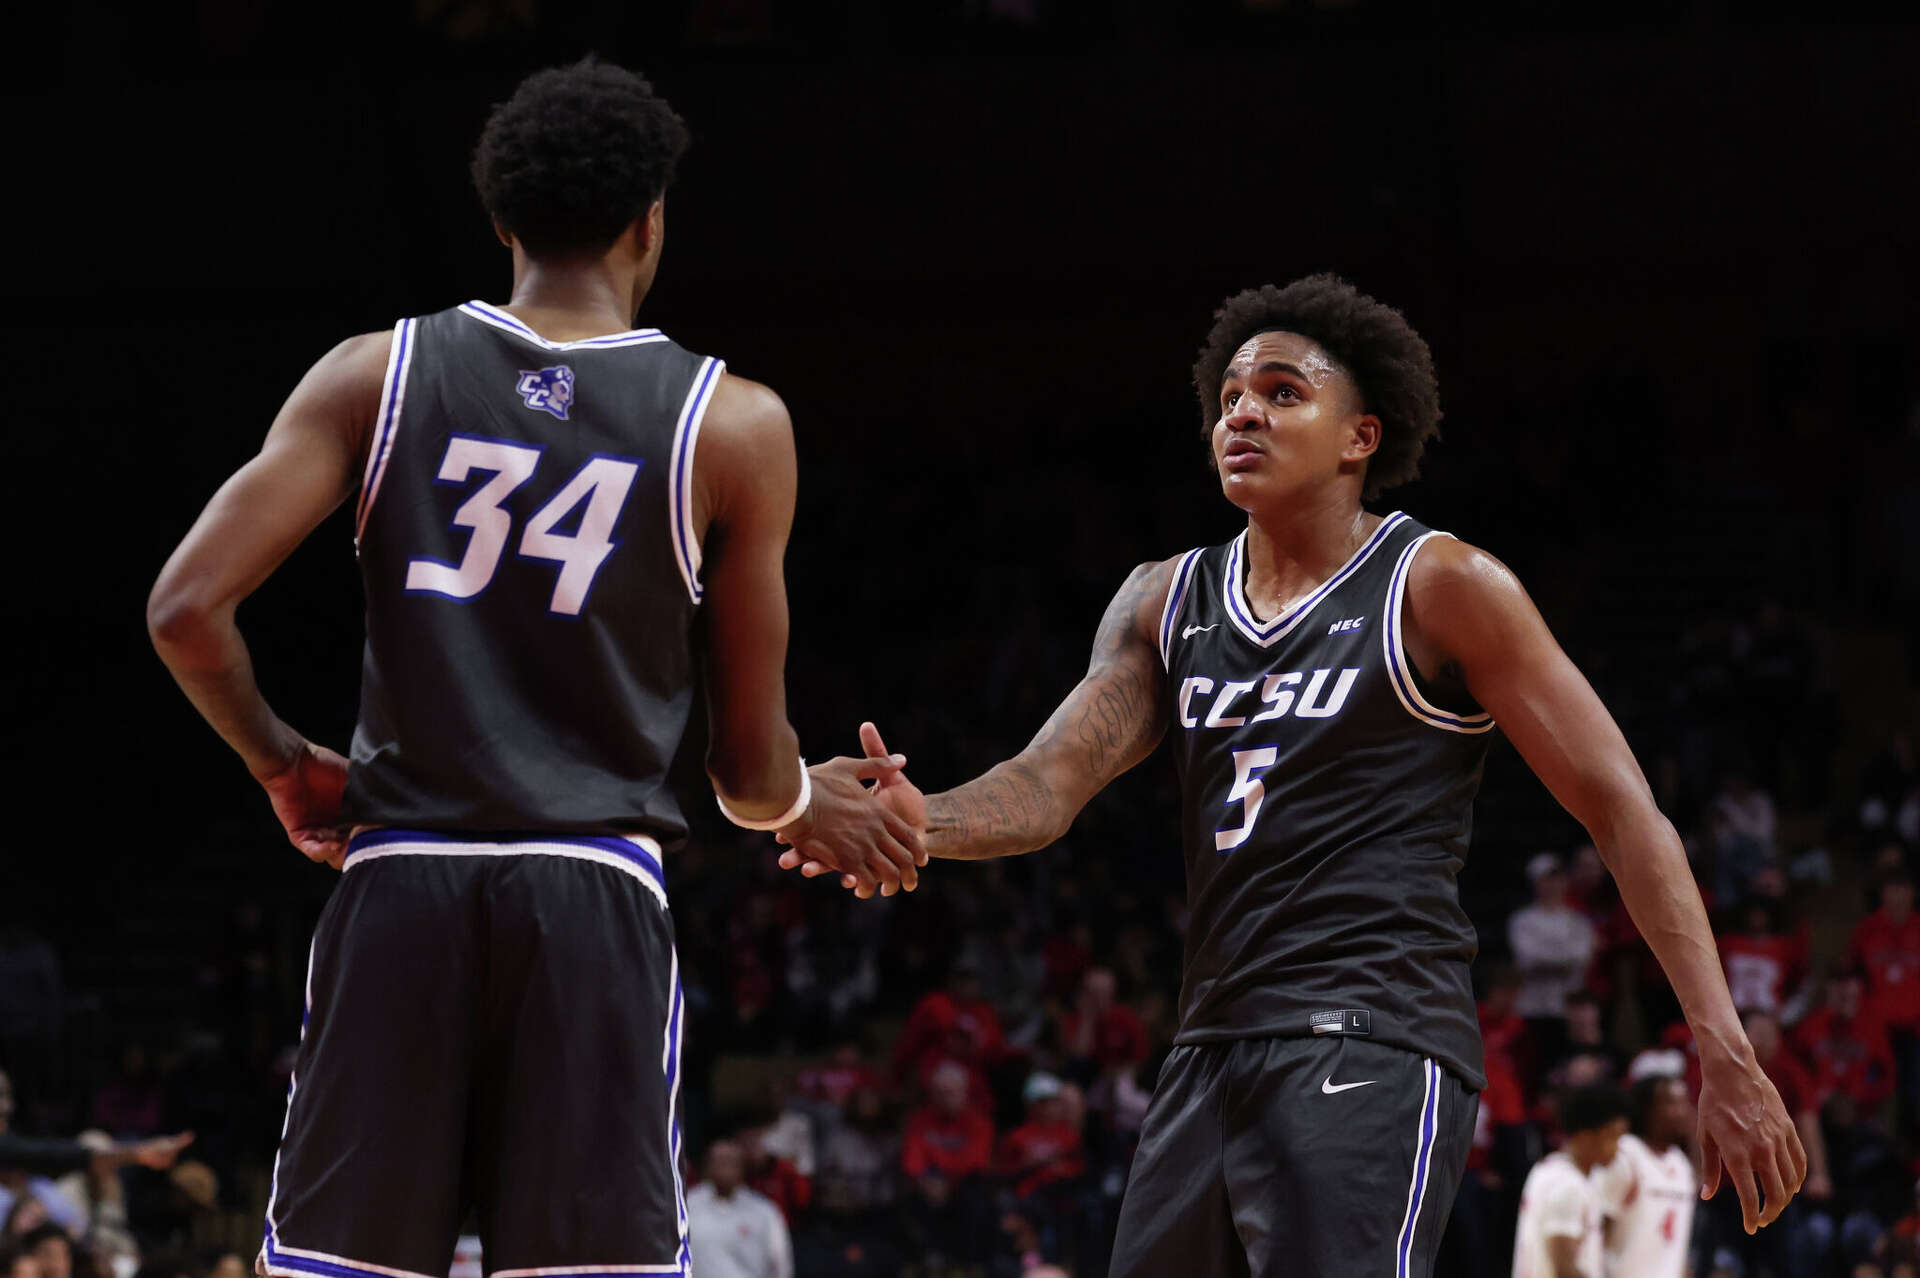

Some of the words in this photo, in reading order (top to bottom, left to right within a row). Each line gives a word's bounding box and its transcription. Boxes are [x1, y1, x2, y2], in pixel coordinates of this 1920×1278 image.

[402, 432, 645, 623] 34
[1328, 616, 1365, 635] NEC
[1178, 667, 1362, 730] CCSU
[1214, 743, 1280, 855] 5
[1352, 1015, 1361, 1027] L
